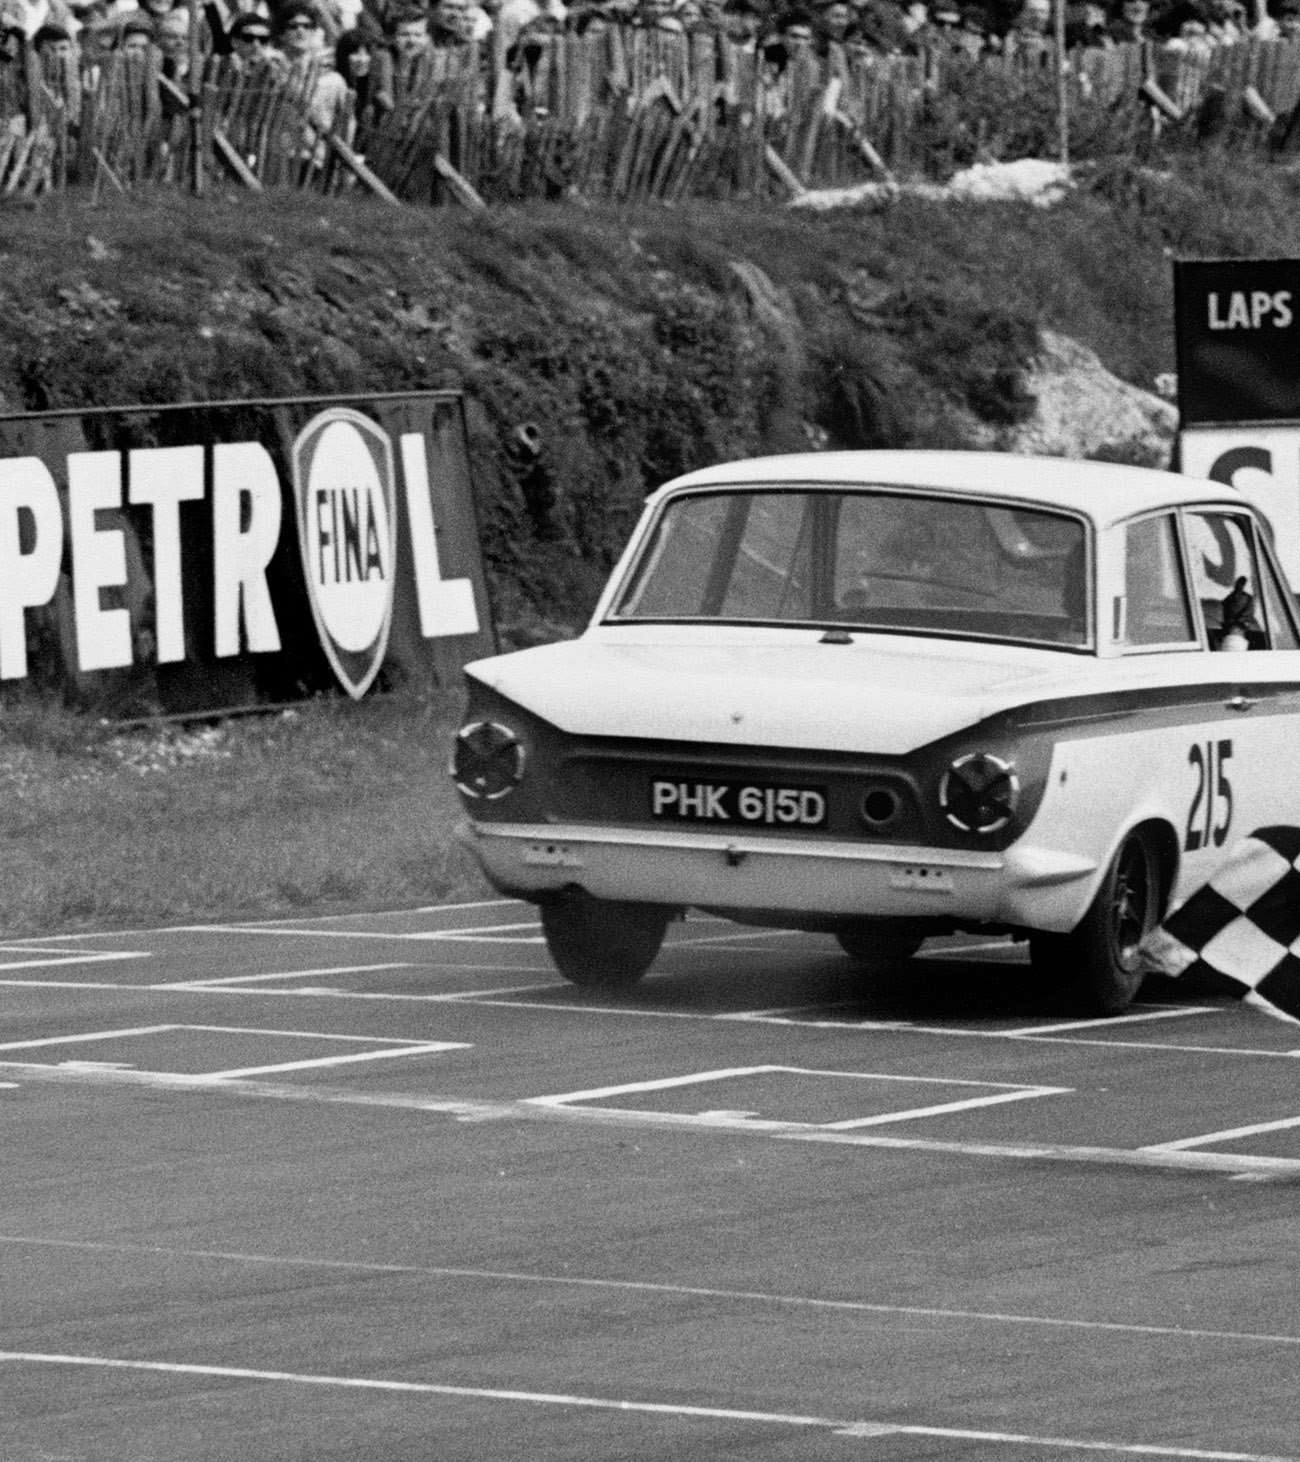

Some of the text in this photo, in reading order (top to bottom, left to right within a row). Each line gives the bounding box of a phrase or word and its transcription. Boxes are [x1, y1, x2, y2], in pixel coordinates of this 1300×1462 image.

[1208, 291, 1292, 328] LAPS
[316, 488, 384, 585] FINA
[653, 781, 825, 824] PHK 615D
[1184, 739, 1233, 852] 215
